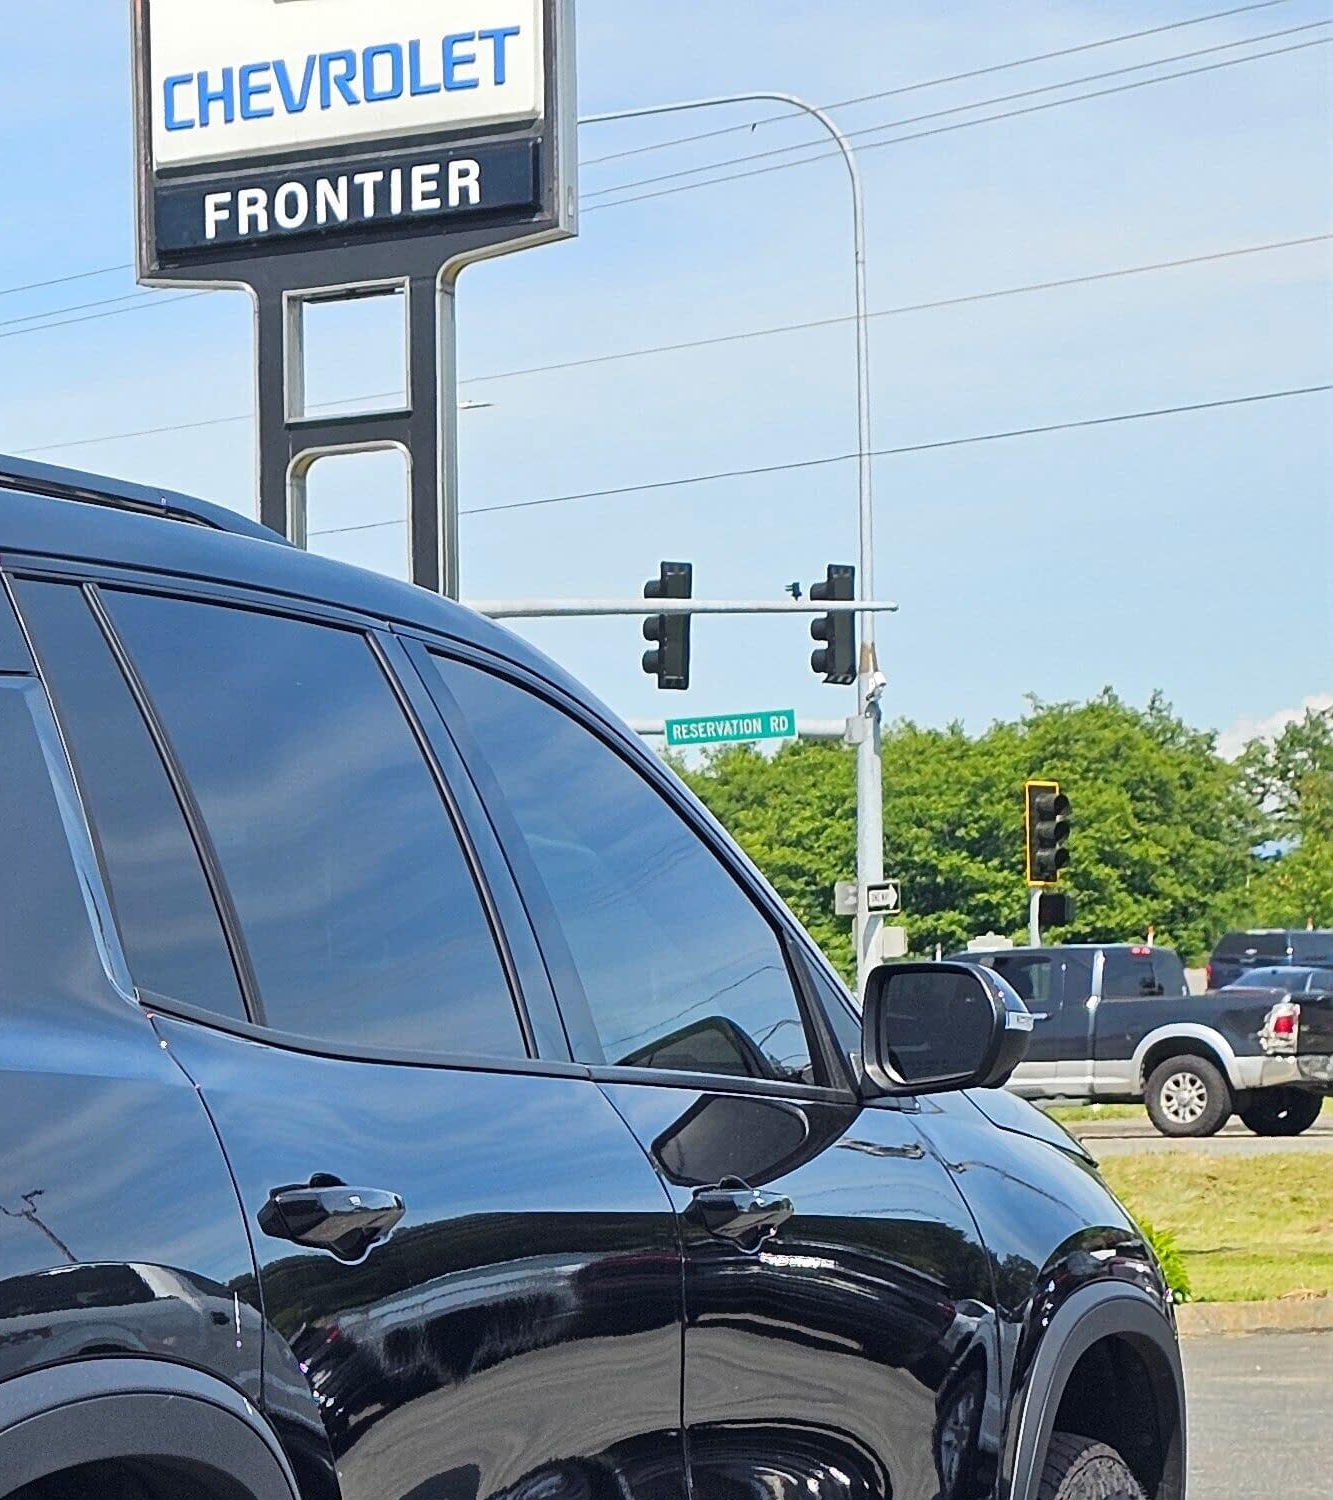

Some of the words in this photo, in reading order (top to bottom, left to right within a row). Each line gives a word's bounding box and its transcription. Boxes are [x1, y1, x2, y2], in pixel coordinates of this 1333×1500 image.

[163, 26, 520, 131] CHEVROLET
[204, 159, 481, 239] FRONTIER
[672, 718, 763, 740] RESERVATION
[770, 716, 789, 733] RD
